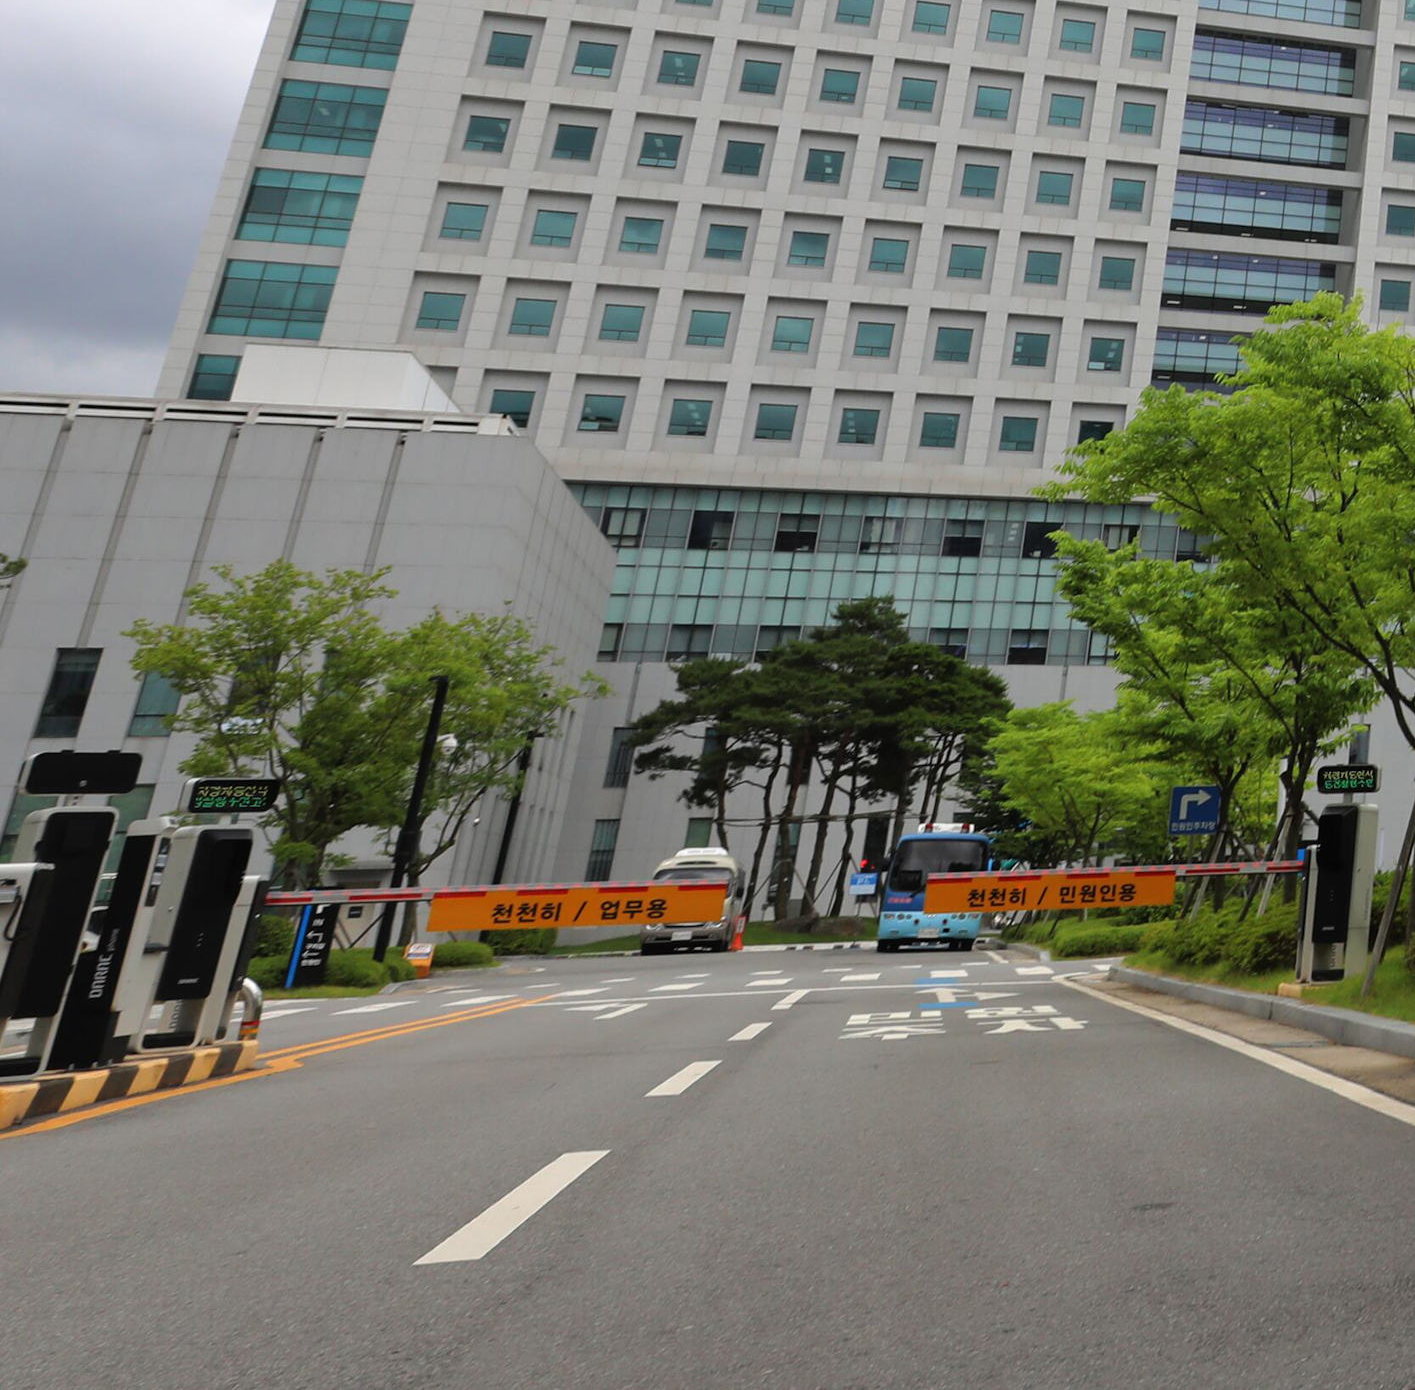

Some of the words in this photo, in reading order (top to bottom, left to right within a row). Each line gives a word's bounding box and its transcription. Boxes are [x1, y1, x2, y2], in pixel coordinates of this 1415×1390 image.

[967, 886, 1027, 908] 천천히
[1059, 883, 1136, 904] 민원인용
[491, 900, 562, 924] 천천히
[600, 898, 667, 920] 업무용
